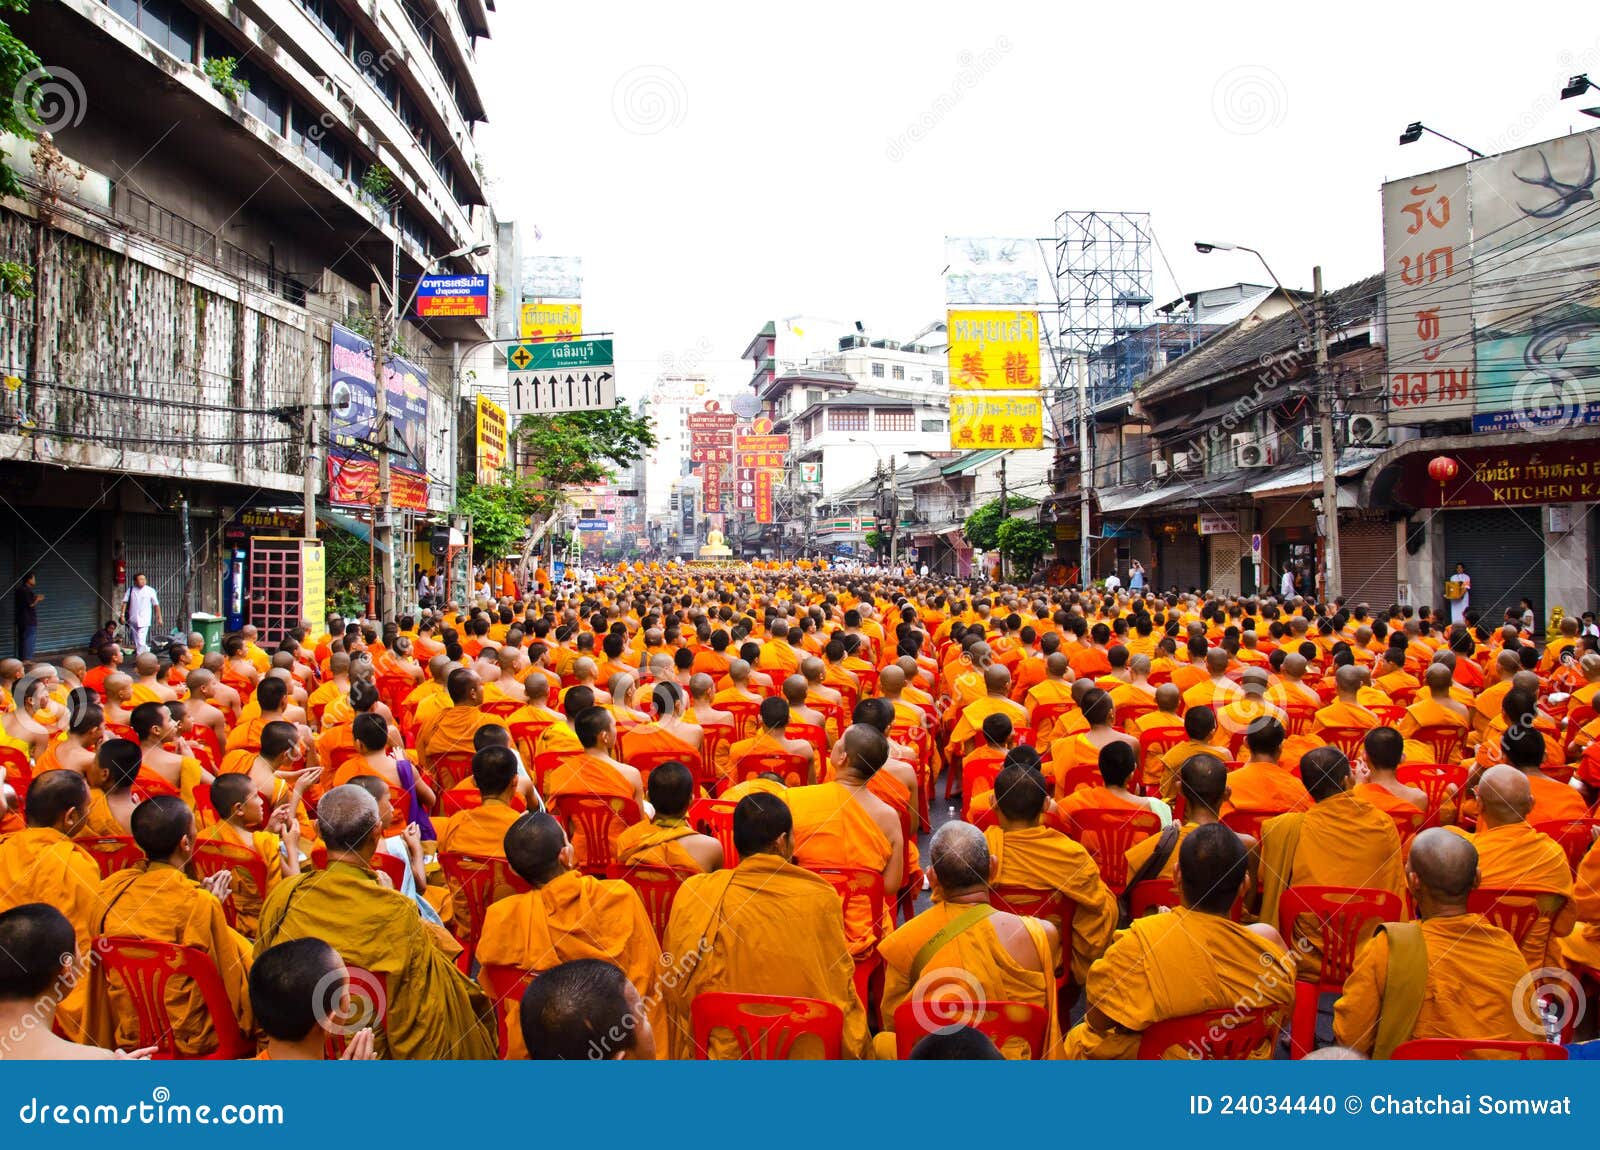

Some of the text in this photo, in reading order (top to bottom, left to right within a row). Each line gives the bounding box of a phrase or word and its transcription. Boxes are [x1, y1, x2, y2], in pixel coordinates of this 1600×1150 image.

[1401, 184, 1450, 234] รัง
[552, 342, 594, 360] เฉลิมบุรี
[1479, 424, 1502, 432] THAI
[1494, 485, 1573, 501] KITCHEN
